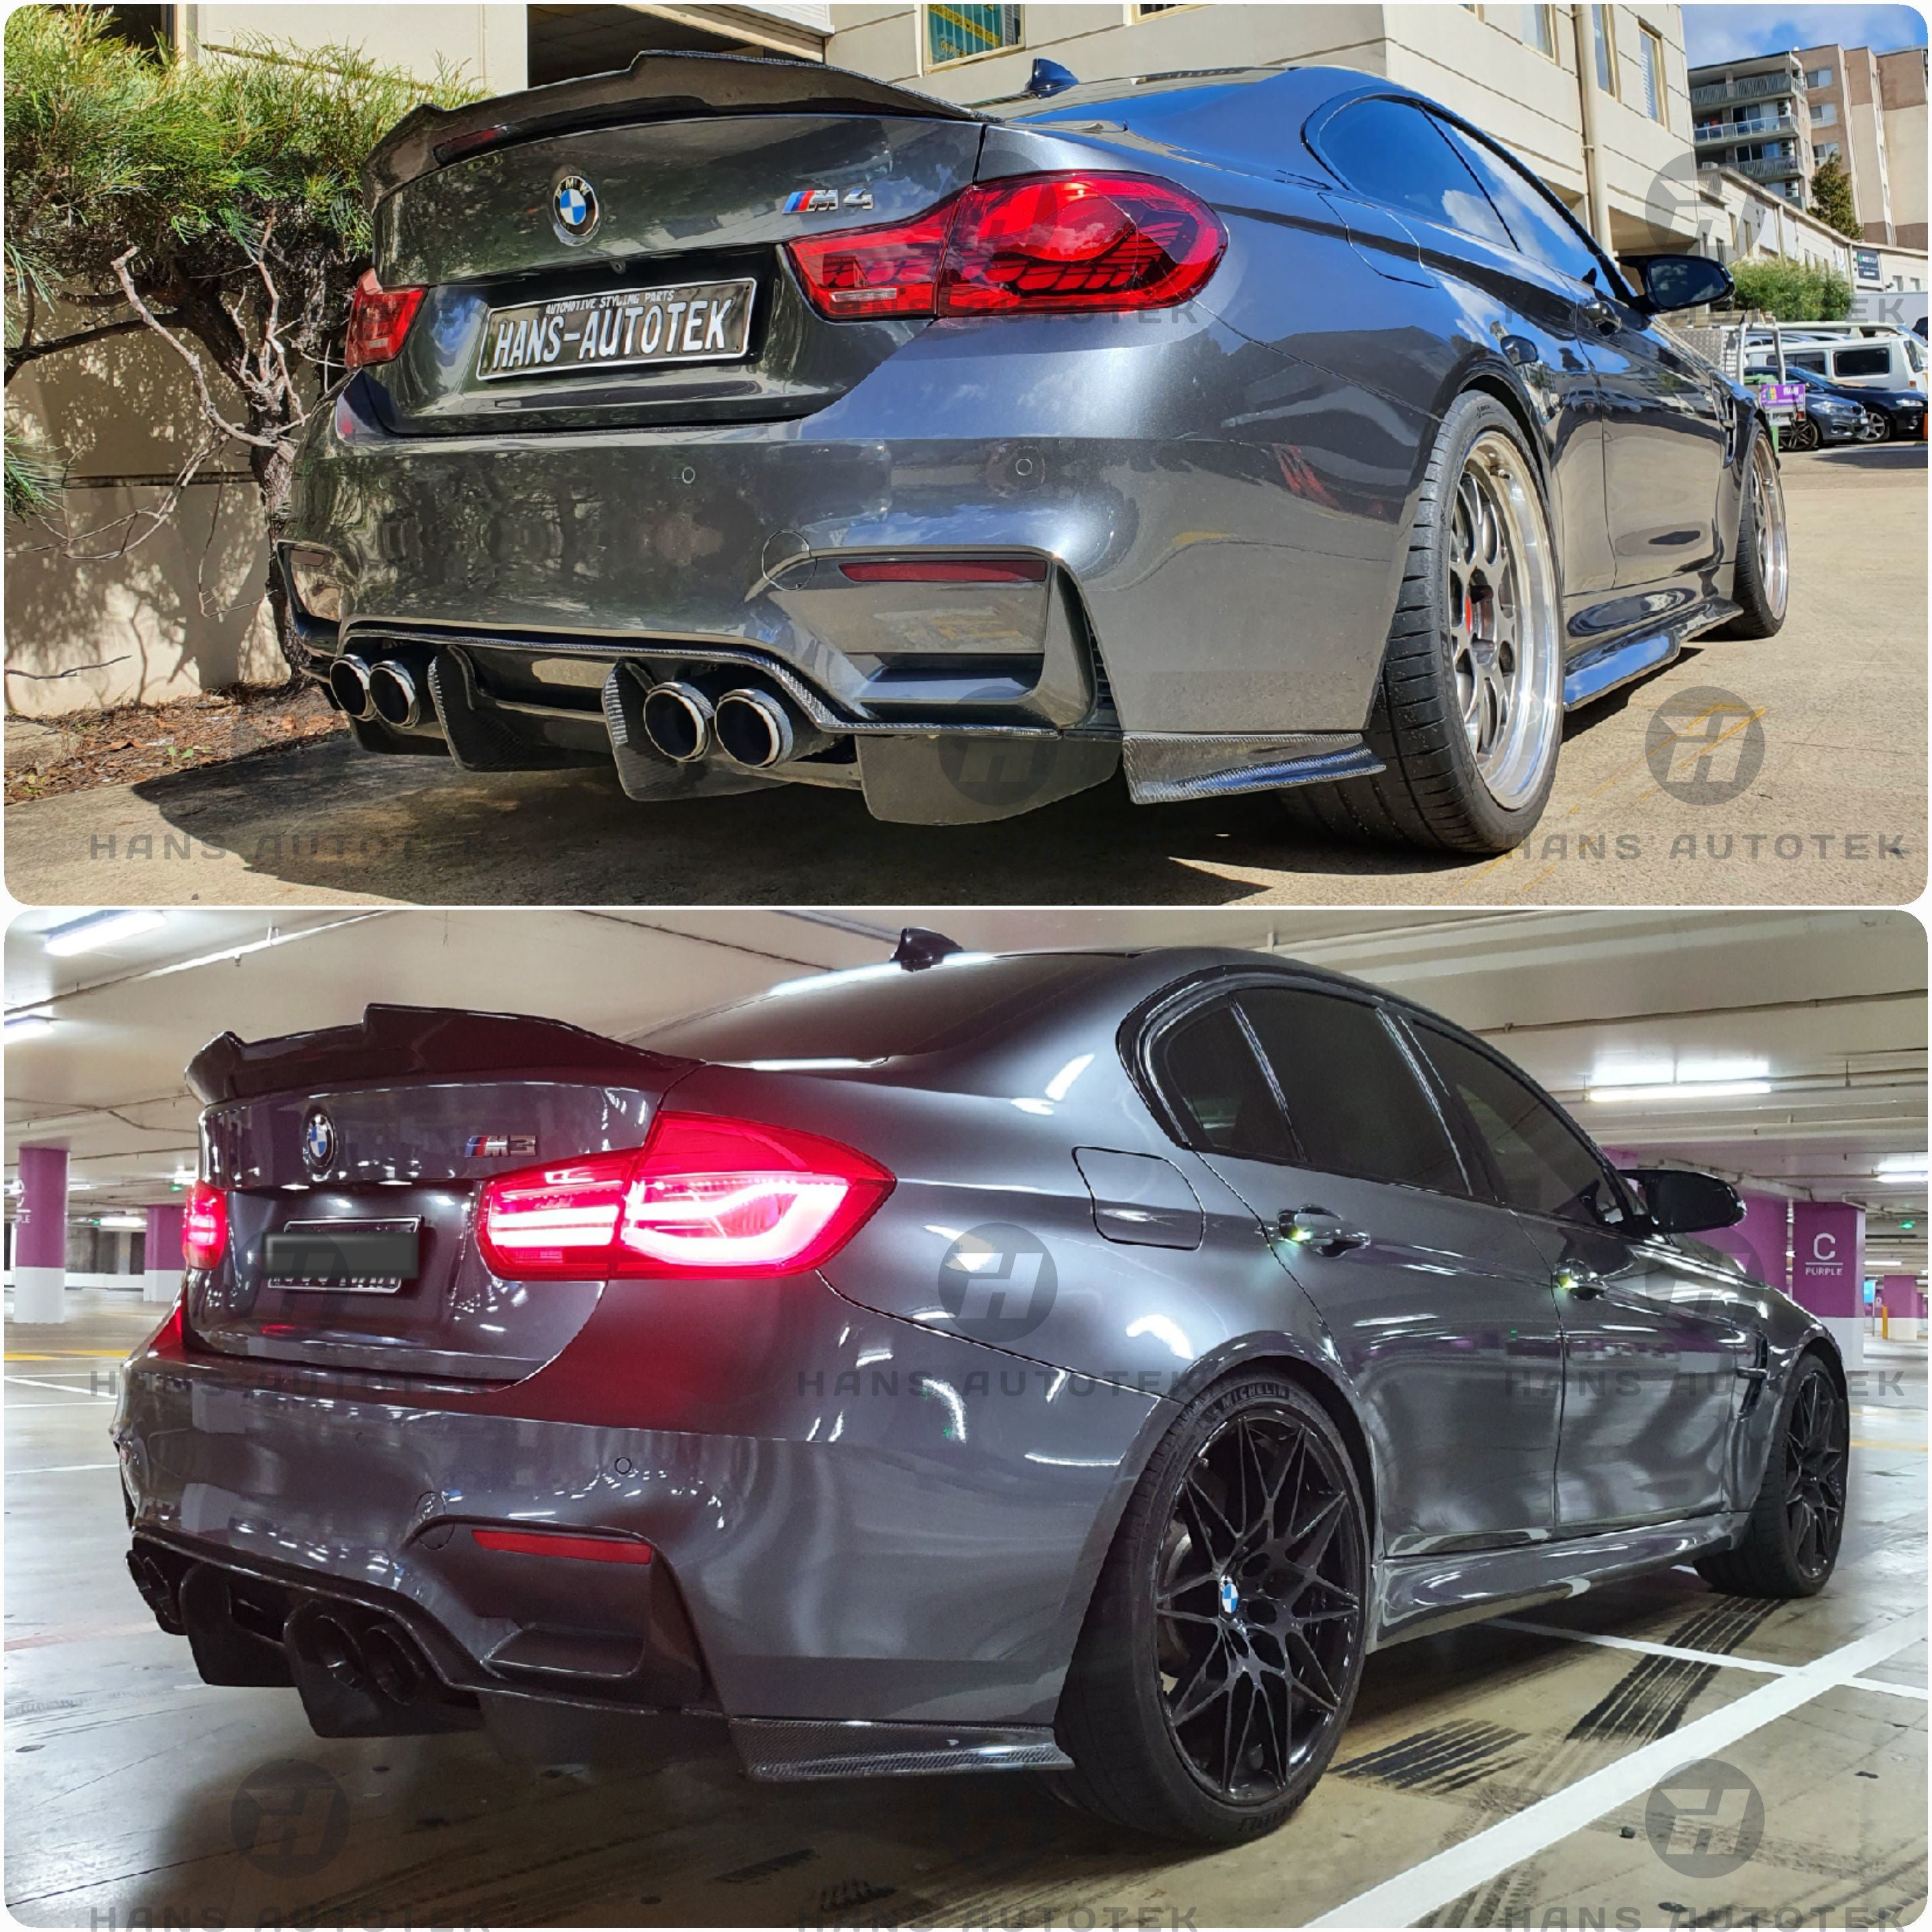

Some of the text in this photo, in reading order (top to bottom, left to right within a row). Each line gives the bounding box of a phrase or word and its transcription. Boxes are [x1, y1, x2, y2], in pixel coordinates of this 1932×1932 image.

[546, 290, 675, 314] AUTOMOTIVE STYLING PARTS
[493, 299, 732, 369] HANS-AUTOTEK
[485, 1135, 536, 1157] M3
[1813, 1233, 1835, 1260] C
[1805, 1267, 1843, 1276] PURPLE
[1221, 1383, 1287, 1409] MICHELIN
